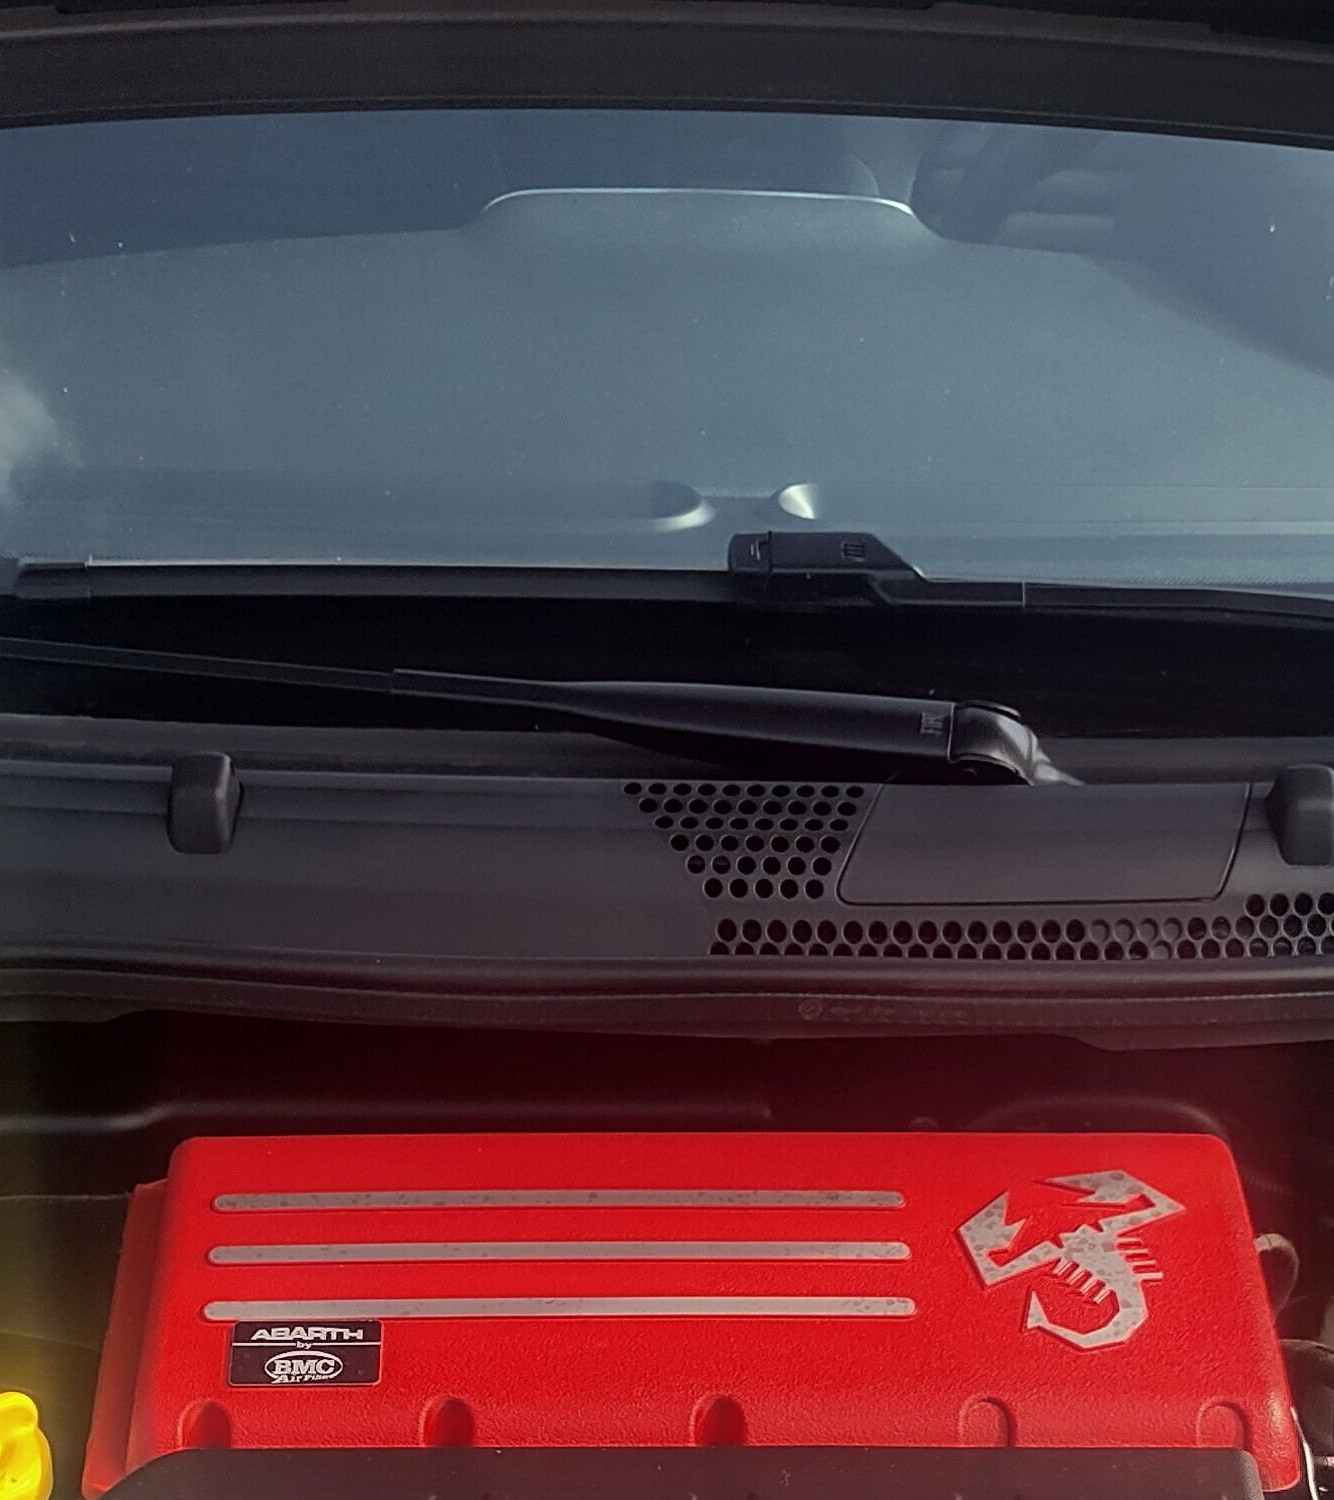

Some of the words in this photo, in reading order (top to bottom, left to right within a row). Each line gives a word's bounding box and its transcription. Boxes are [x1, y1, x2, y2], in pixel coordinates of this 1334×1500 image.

[251, 1327, 364, 1341] ABARTH
[296, 1341, 313, 1349] by
[271, 1359, 336, 1375] BMC
